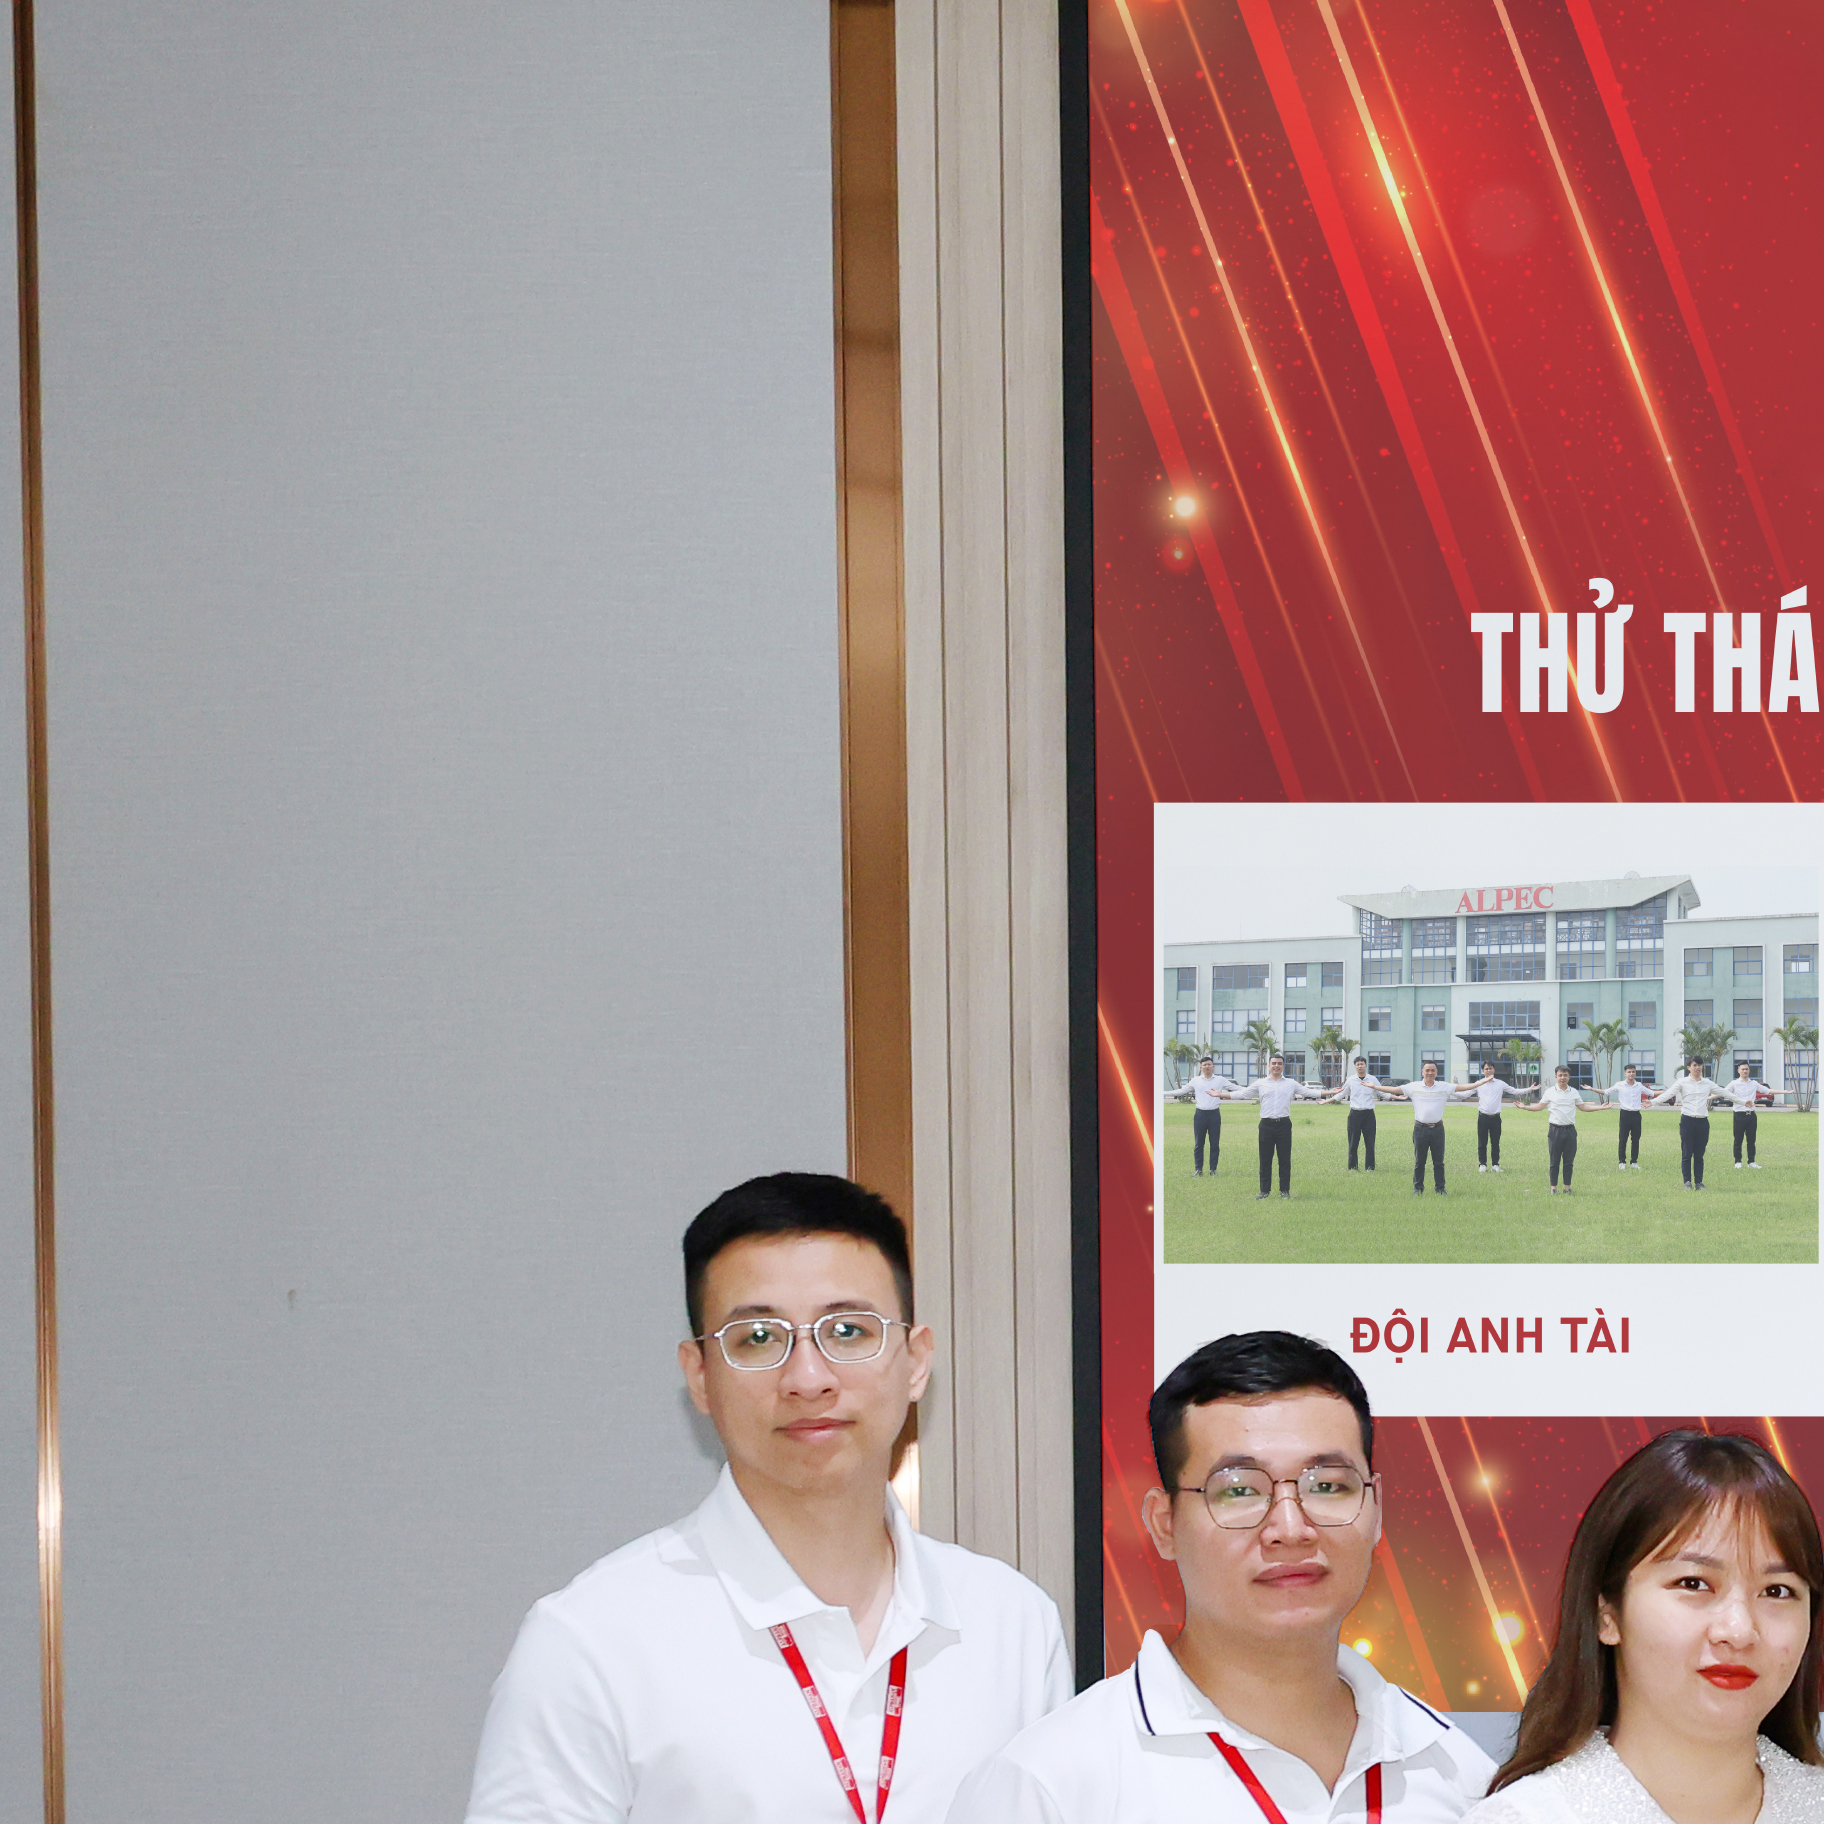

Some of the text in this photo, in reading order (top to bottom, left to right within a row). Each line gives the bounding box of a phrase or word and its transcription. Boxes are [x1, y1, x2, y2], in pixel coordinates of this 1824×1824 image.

[1471, 578, 1634, 713] THỬ
[1456, 886, 1554, 913] ALPEC
[1350, 1307, 1632, 1364] ĐỘI ANH TÀI
